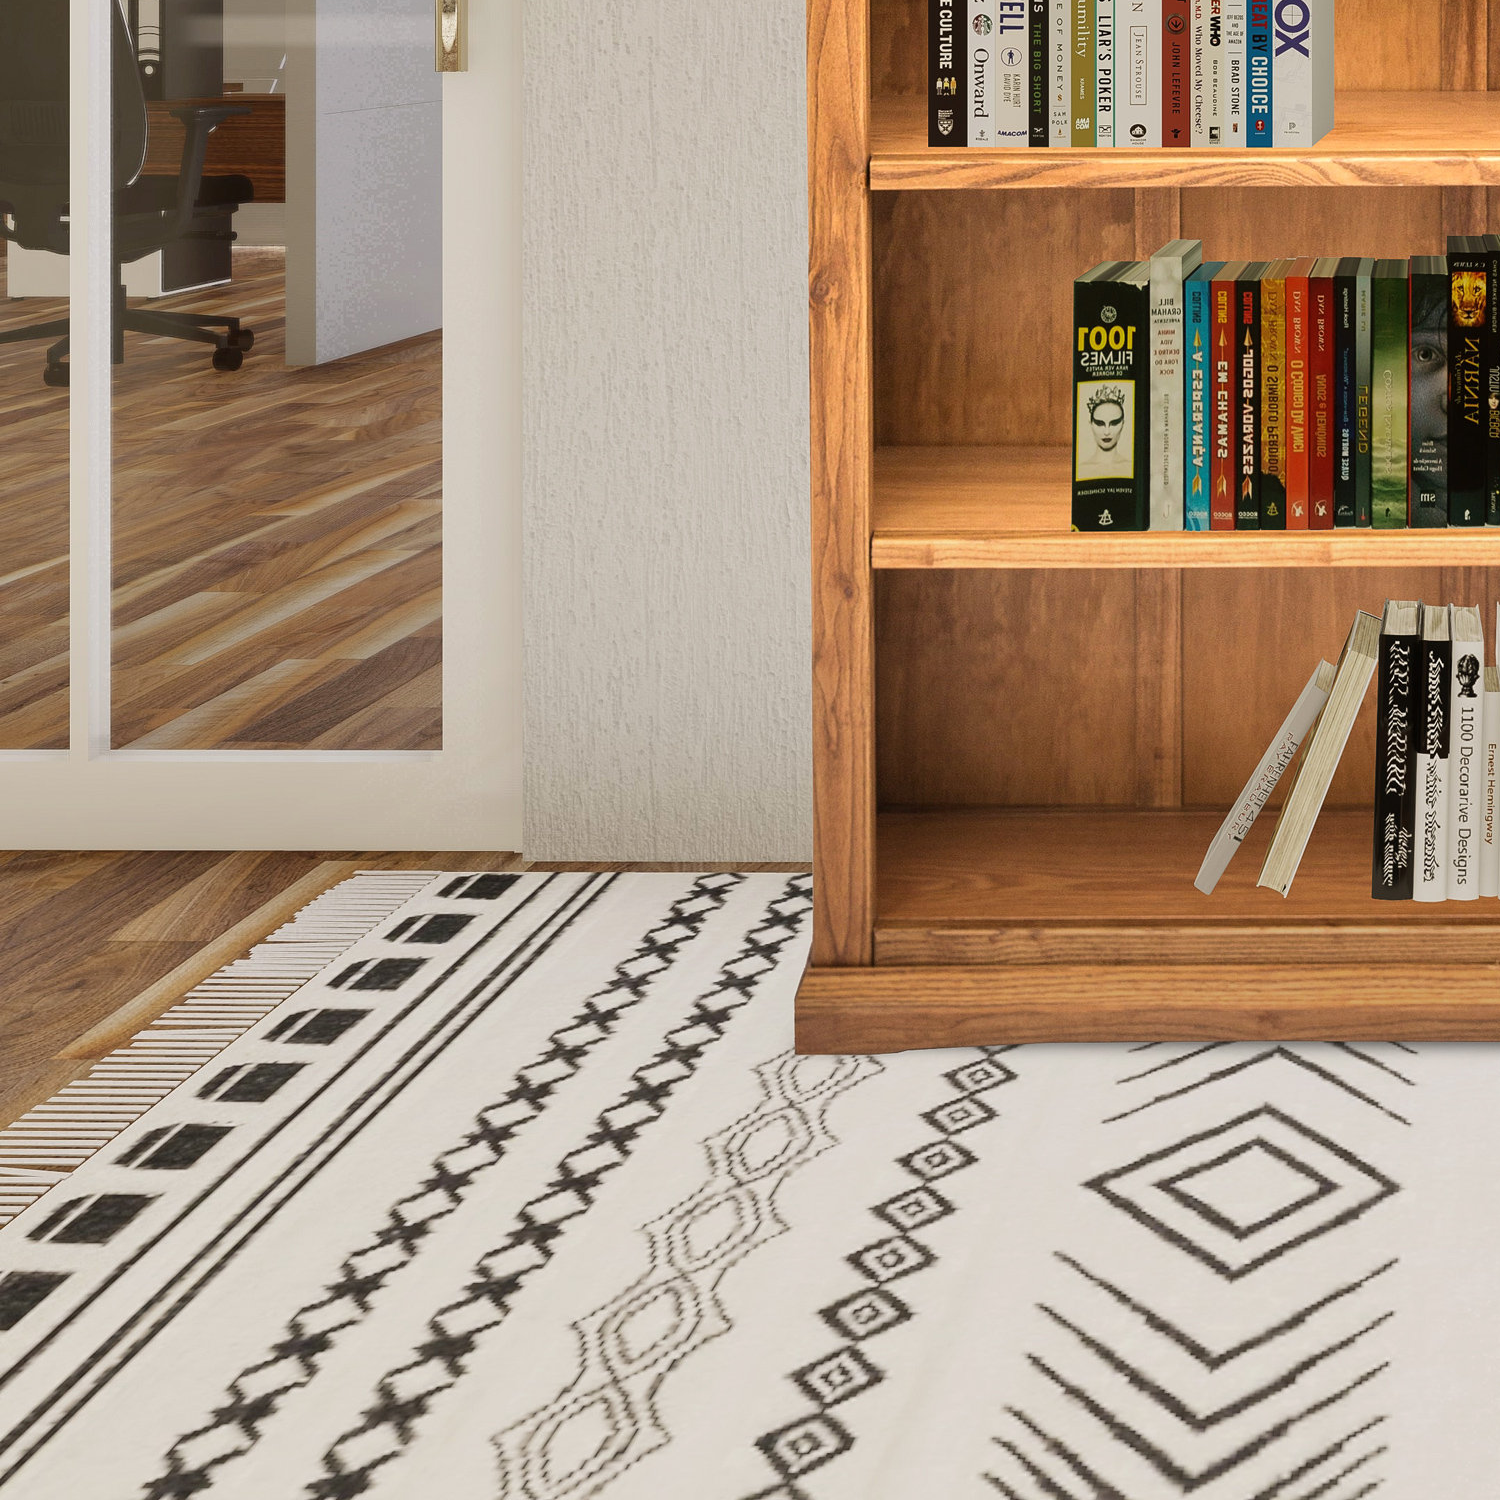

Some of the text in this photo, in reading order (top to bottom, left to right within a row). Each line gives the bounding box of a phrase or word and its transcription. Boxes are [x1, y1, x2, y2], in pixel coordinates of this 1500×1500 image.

[940, 10, 952, 70] CULTURE
[1056, 18, 1063, 36] OF
[1252, 34, 1268, 52] BY
[973, 47, 990, 118] Onward
[1012, 74, 1020, 108] KARIN HURT
[1033, 22, 1042, 114] THE BIG SHORT
[1098, 15, 1112, 113] LIAR'S POKER
[1172, 42, 1181, 115] JOHN LEFEVRE
[1193, 26, 1203, 134] Who Moved My Cheese?
[1231, 60, 1240, 116] BRAD STONE
[1252, 56, 1268, 114] CHOICE
[1460, 707, 1474, 742] 1100
[1233, 740, 1299, 842] FAHRENHEIT 451
[1484, 743, 1496, 845] Ernest Hemingway
[1453, 828, 1472, 885] Designs
